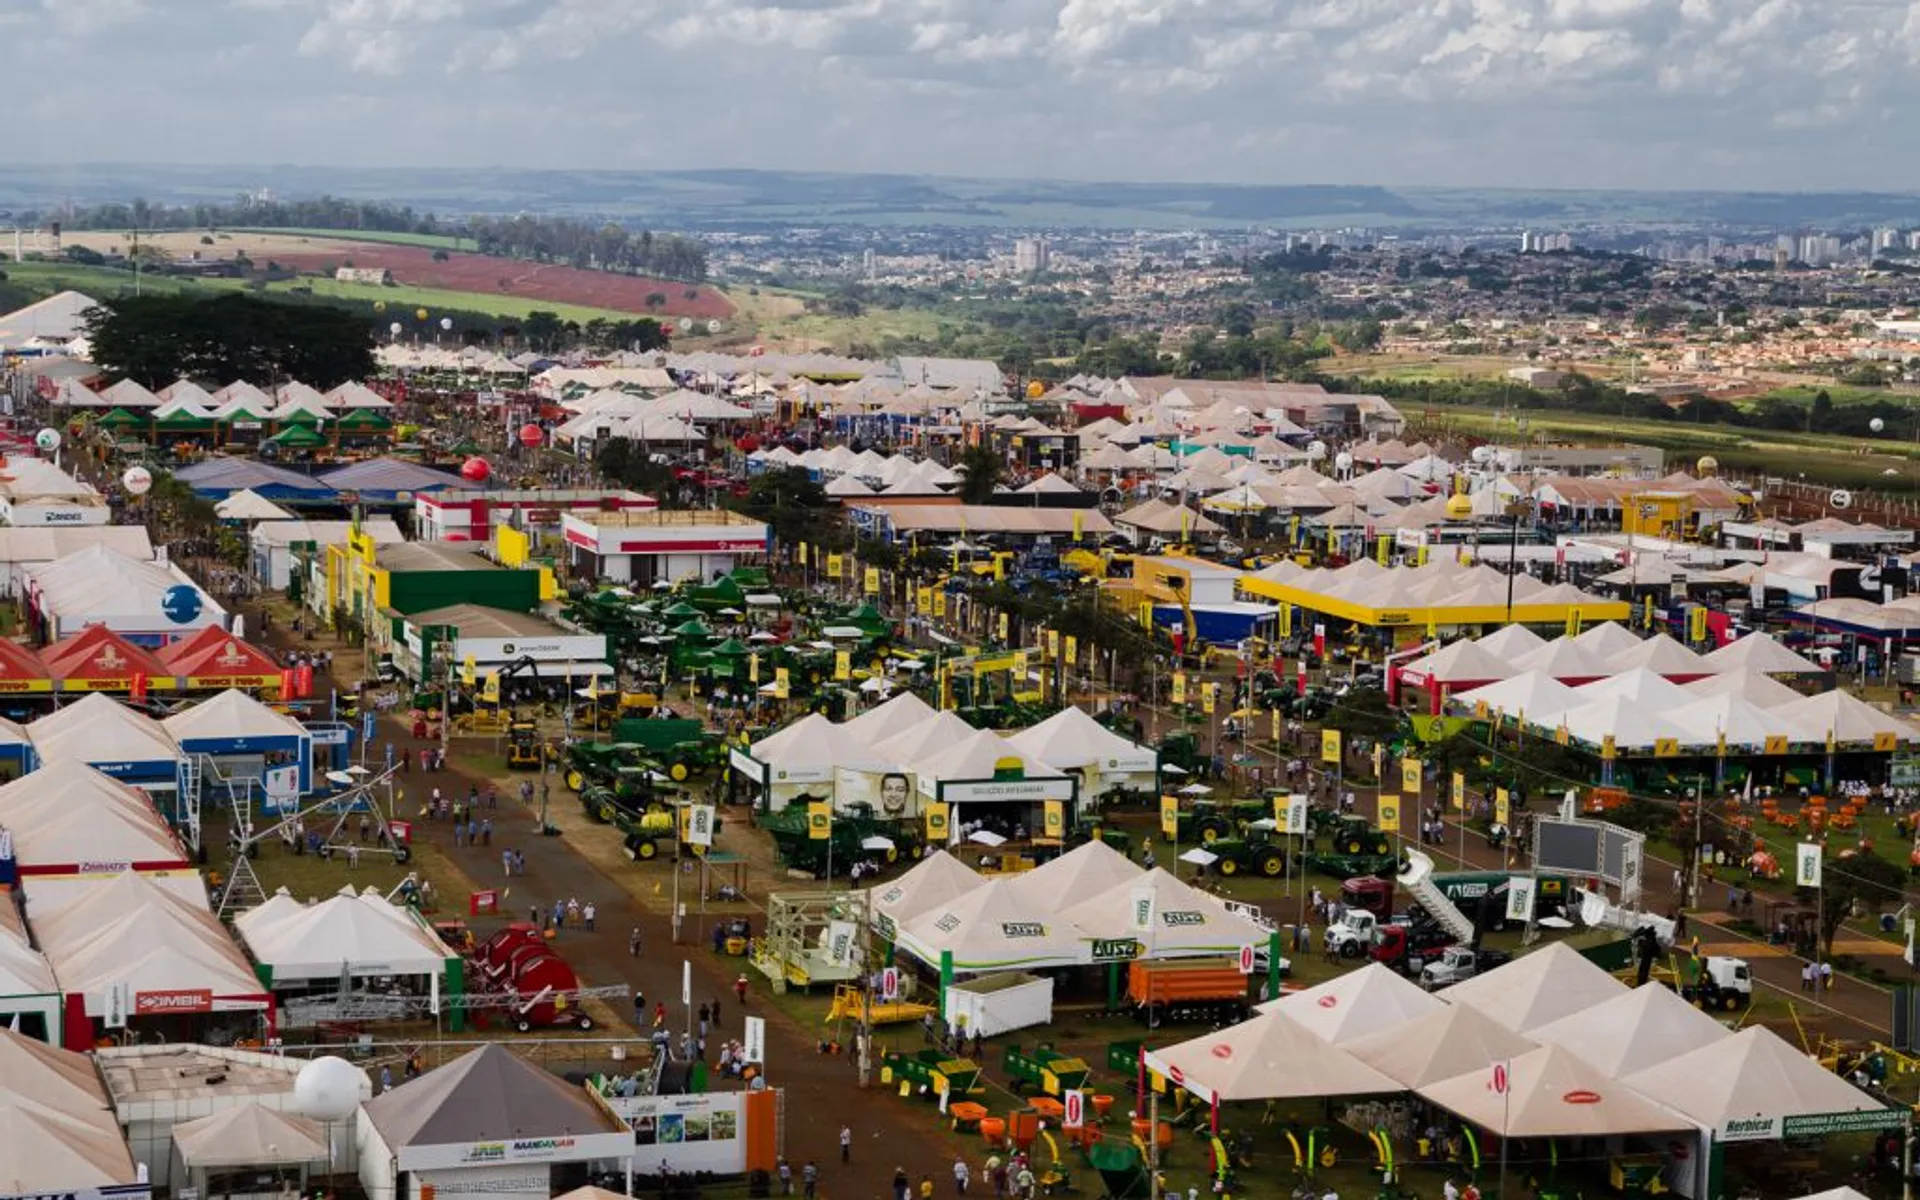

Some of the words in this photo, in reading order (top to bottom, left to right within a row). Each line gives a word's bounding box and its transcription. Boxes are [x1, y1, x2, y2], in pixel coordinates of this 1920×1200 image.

[88, 680, 120, 689] VENCE
[199, 678, 231, 687] VENCE
[235, 678, 264, 687] TUDO
